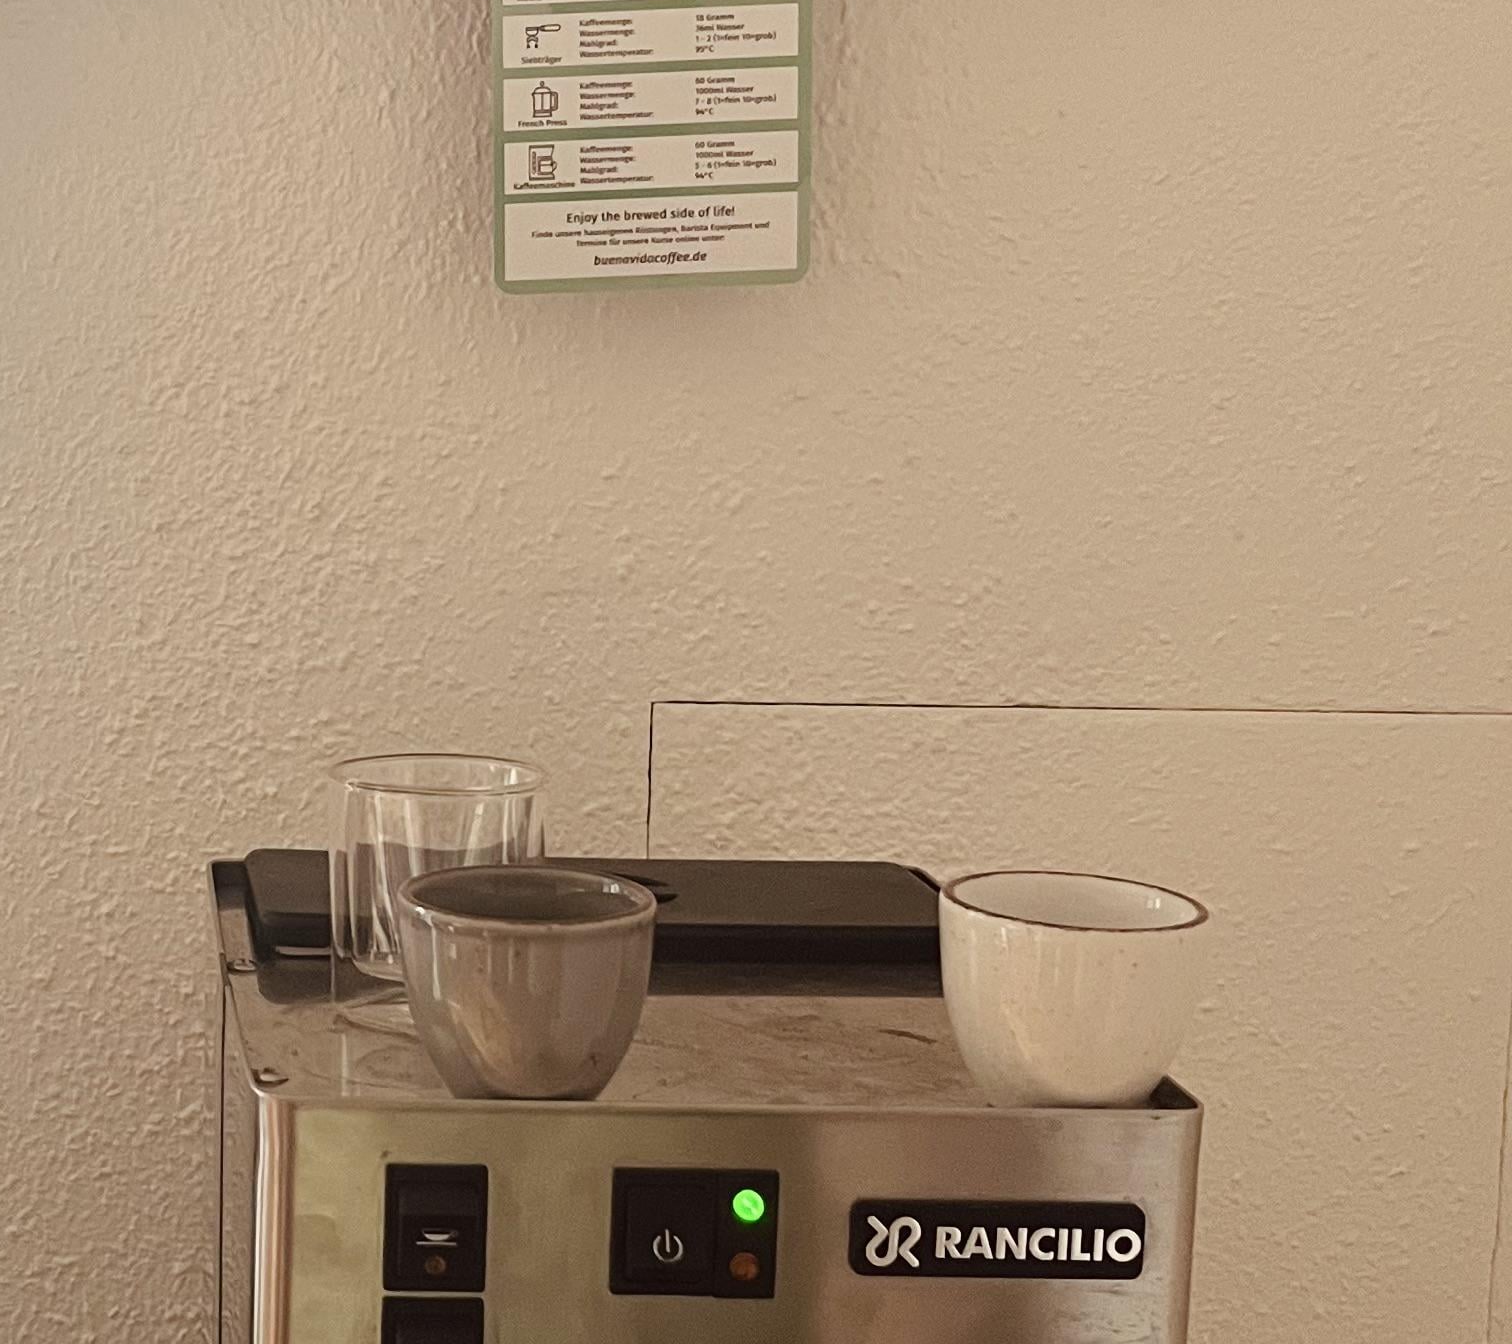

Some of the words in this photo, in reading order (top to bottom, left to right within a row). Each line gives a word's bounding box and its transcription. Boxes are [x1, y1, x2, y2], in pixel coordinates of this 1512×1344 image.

[566, 211, 598, 225] Enjoy
[601, 211, 621, 222] the
[624, 208, 667, 221] brewed
[670, 207, 695, 220] side
[698, 206, 711, 218] of
[713, 205, 736, 218] life!
[593, 251, 707, 266] buenavidacoffee.de
[935, 1226, 1142, 1263] RANCILIO
